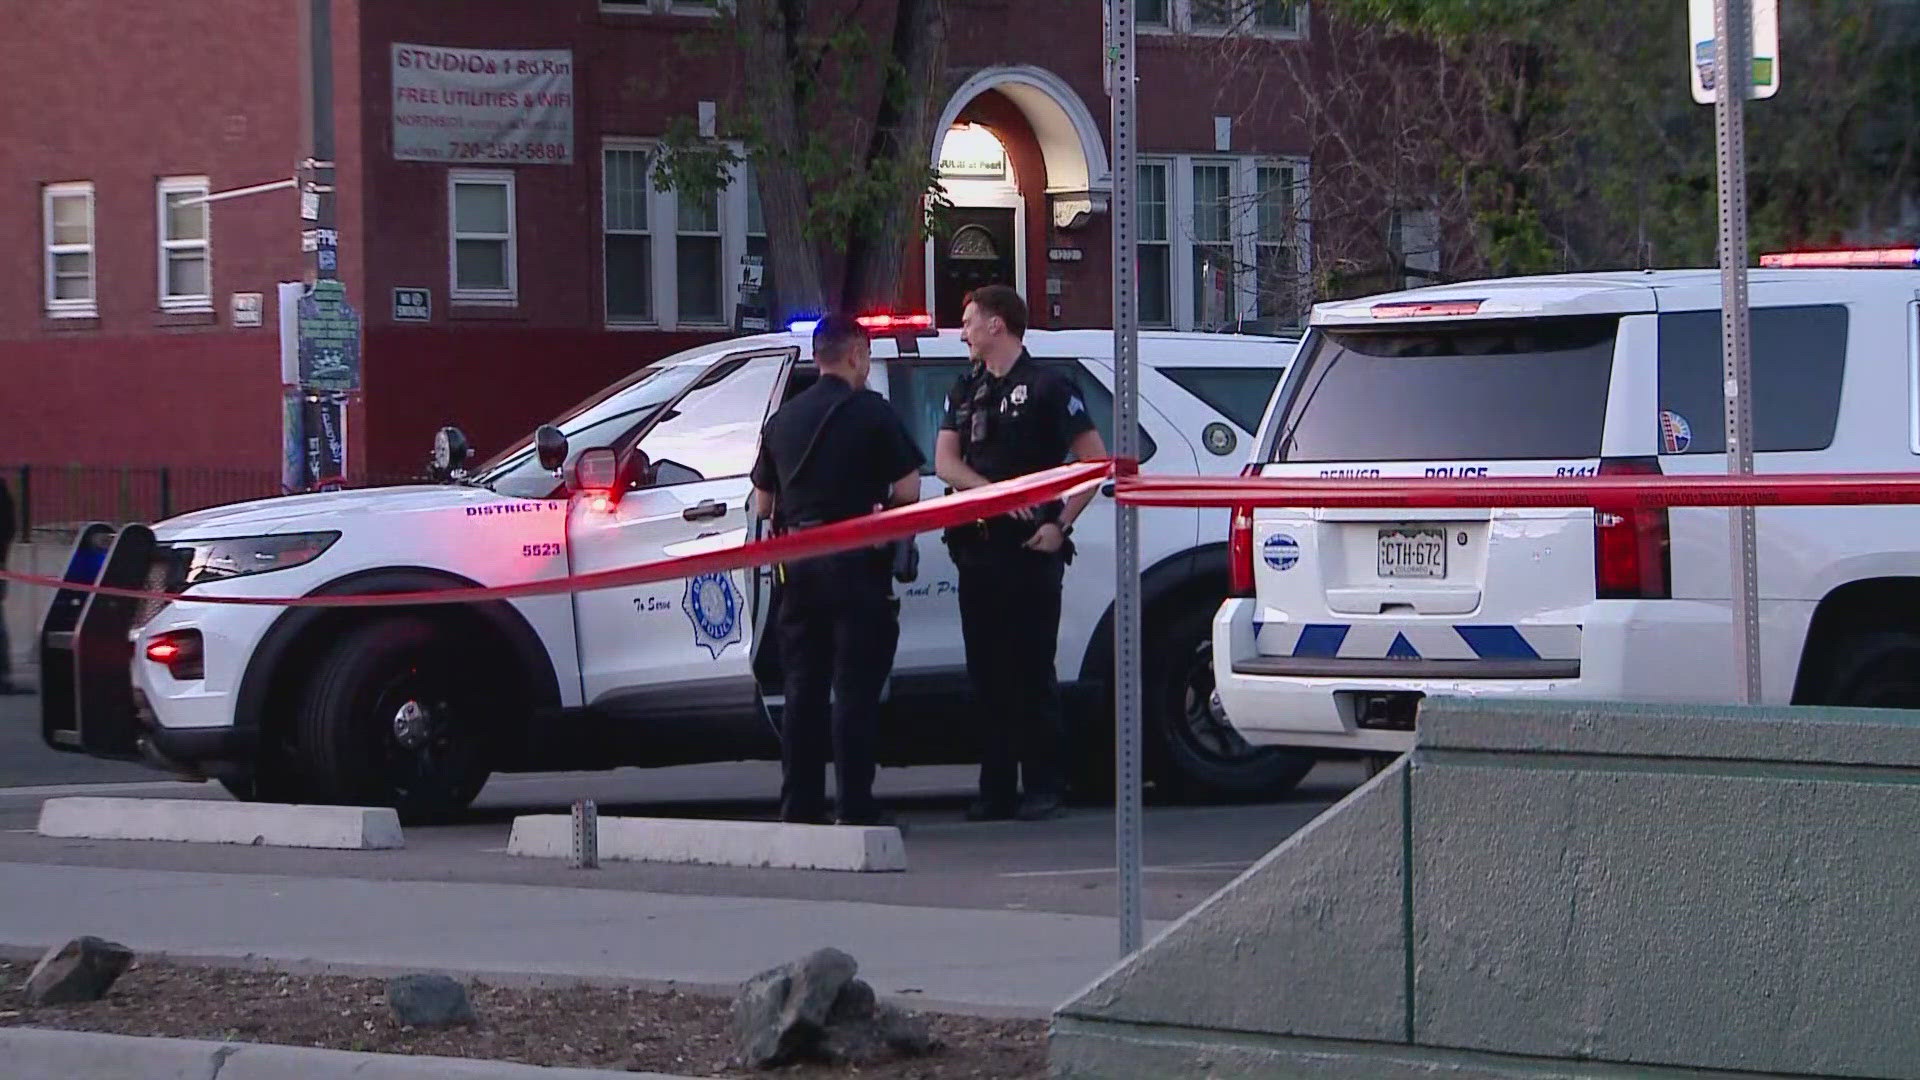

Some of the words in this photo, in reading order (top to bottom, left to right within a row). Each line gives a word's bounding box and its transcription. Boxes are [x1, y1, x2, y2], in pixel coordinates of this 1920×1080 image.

[397, 87, 439, 104] FREE
[444, 88, 519, 108] UTILITIES
[524, 91, 534, 107] &
[1425, 467, 1488, 479] POLICE
[466, 502, 544, 516] DISTRICT
[906, 583, 931, 596] and
[633, 597, 645, 613] To
